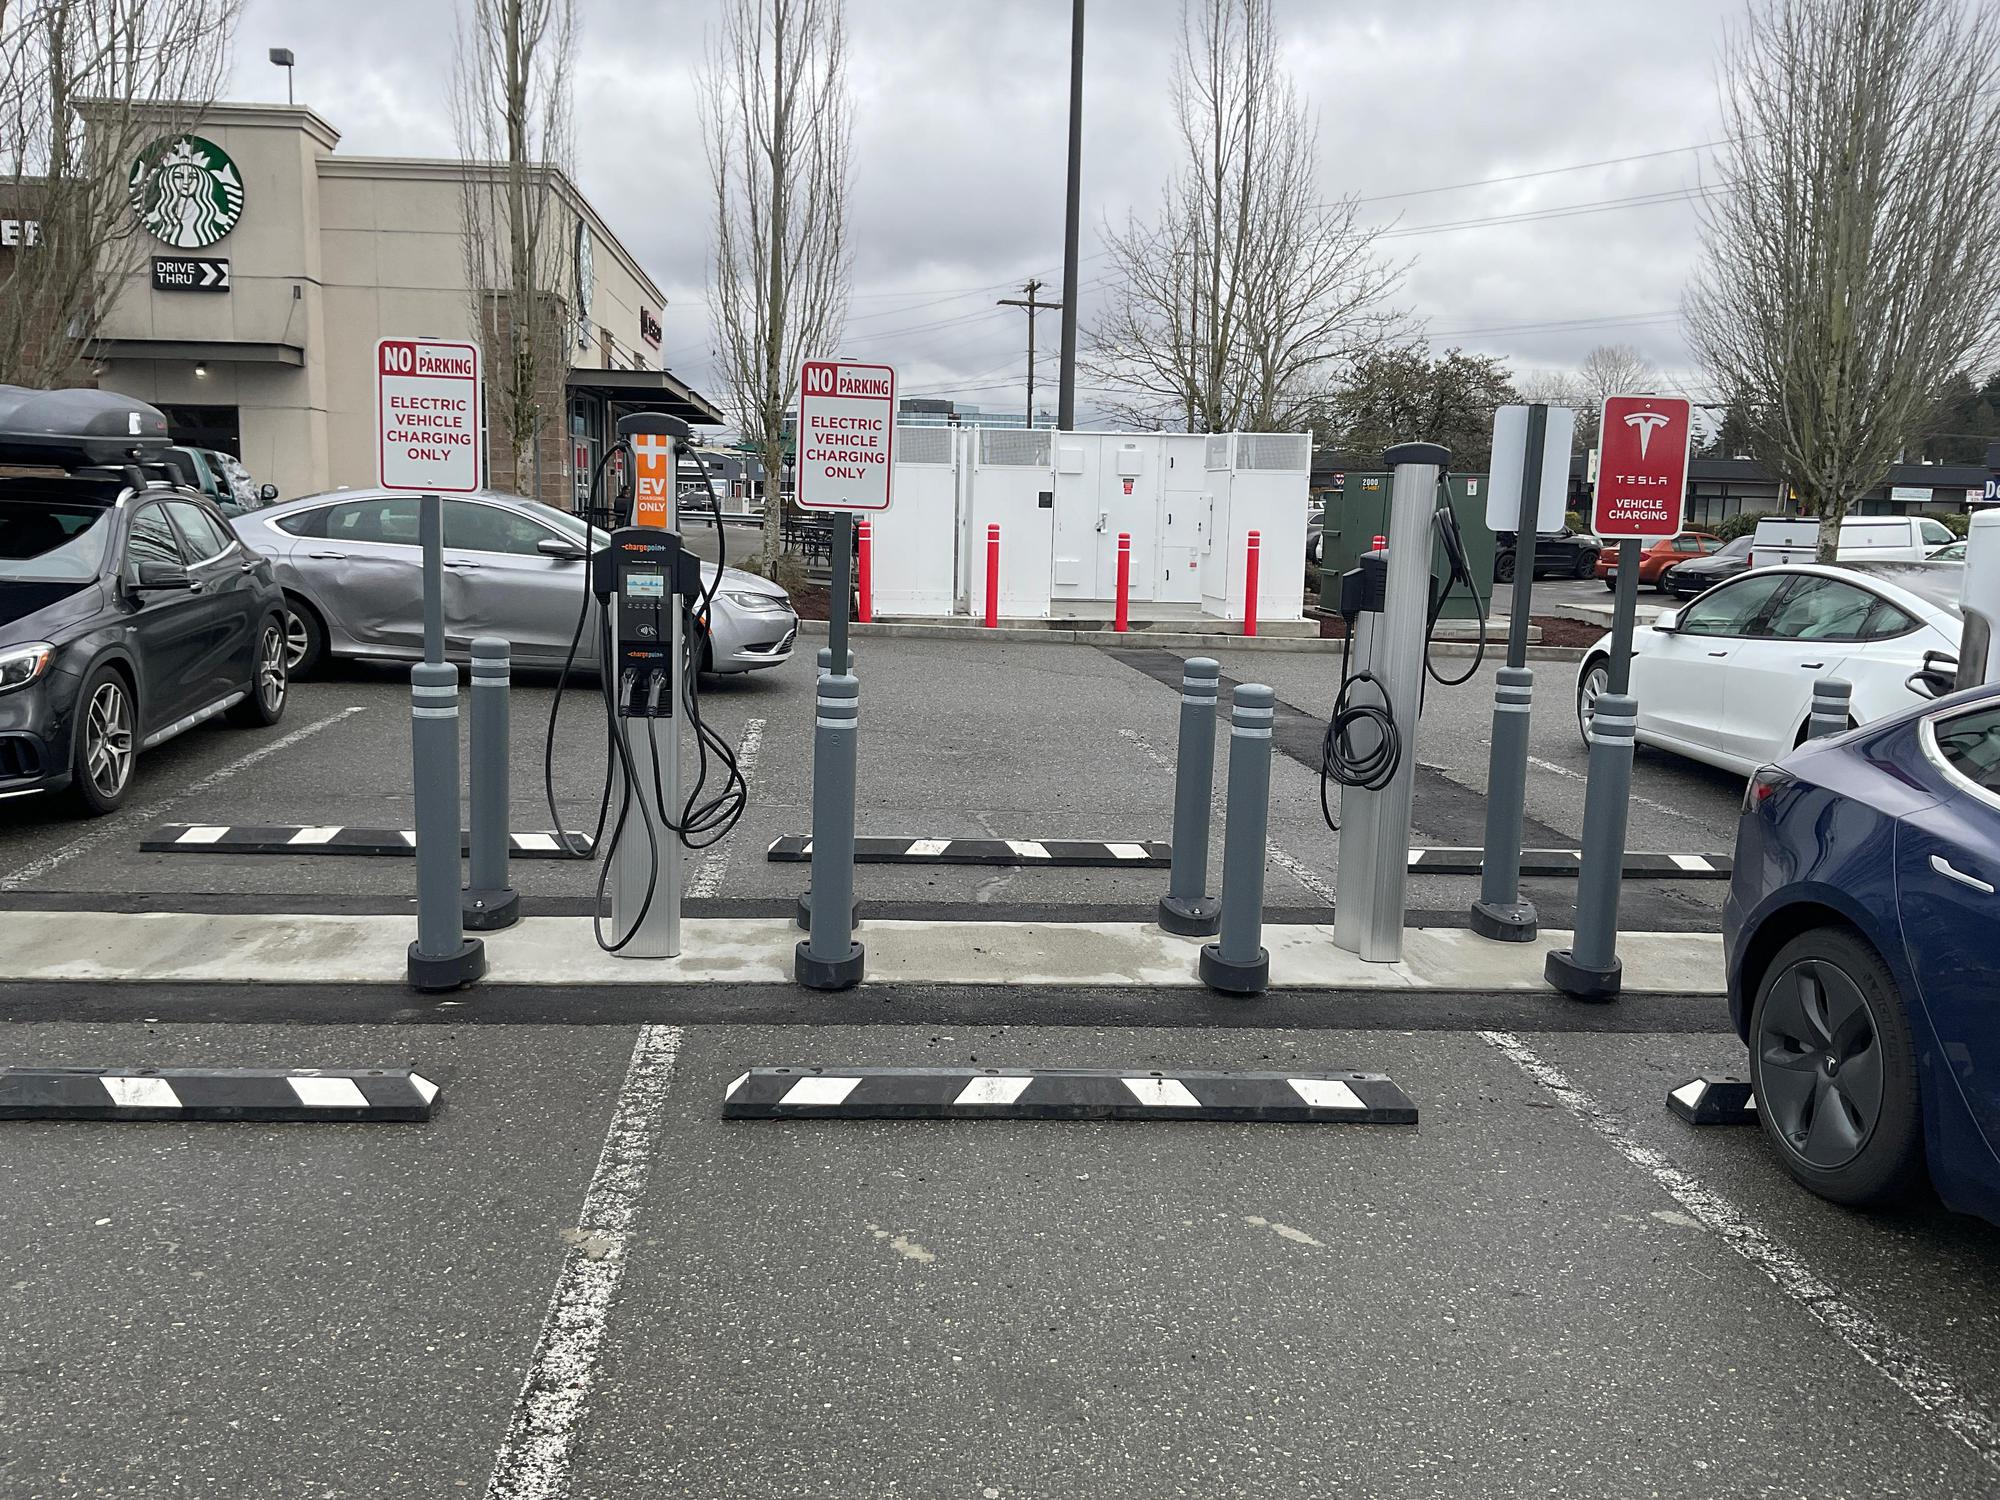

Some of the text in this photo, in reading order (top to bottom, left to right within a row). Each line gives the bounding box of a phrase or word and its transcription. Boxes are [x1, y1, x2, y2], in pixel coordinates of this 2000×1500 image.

[157, 262, 195, 274] DRIVE
[157, 273, 193, 284] THRU
[384, 346, 471, 374] NO PARKING
[807, 367, 889, 395] NO PARKING
[390, 396, 467, 411] ELECTRIC
[395, 413, 463, 428] VEHICLE
[811, 416, 883, 431] ELECTRIC
[386, 430, 471, 445] CHARGING
[815, 433, 878, 447] VEHICLE
[407, 447, 451, 461] ONLY
[806, 449, 885, 464] CHARGING
[824, 466, 866, 479] ONLY
[639, 477, 665, 495] EV
[1362, 478, 1379, 486] 2000
[1615, 475, 1667, 485] TESLA
[639, 502, 665, 512] ONLY
[1616, 499, 1663, 509] VEHICLE
[1608, 510, 1668, 520] CHARGING
